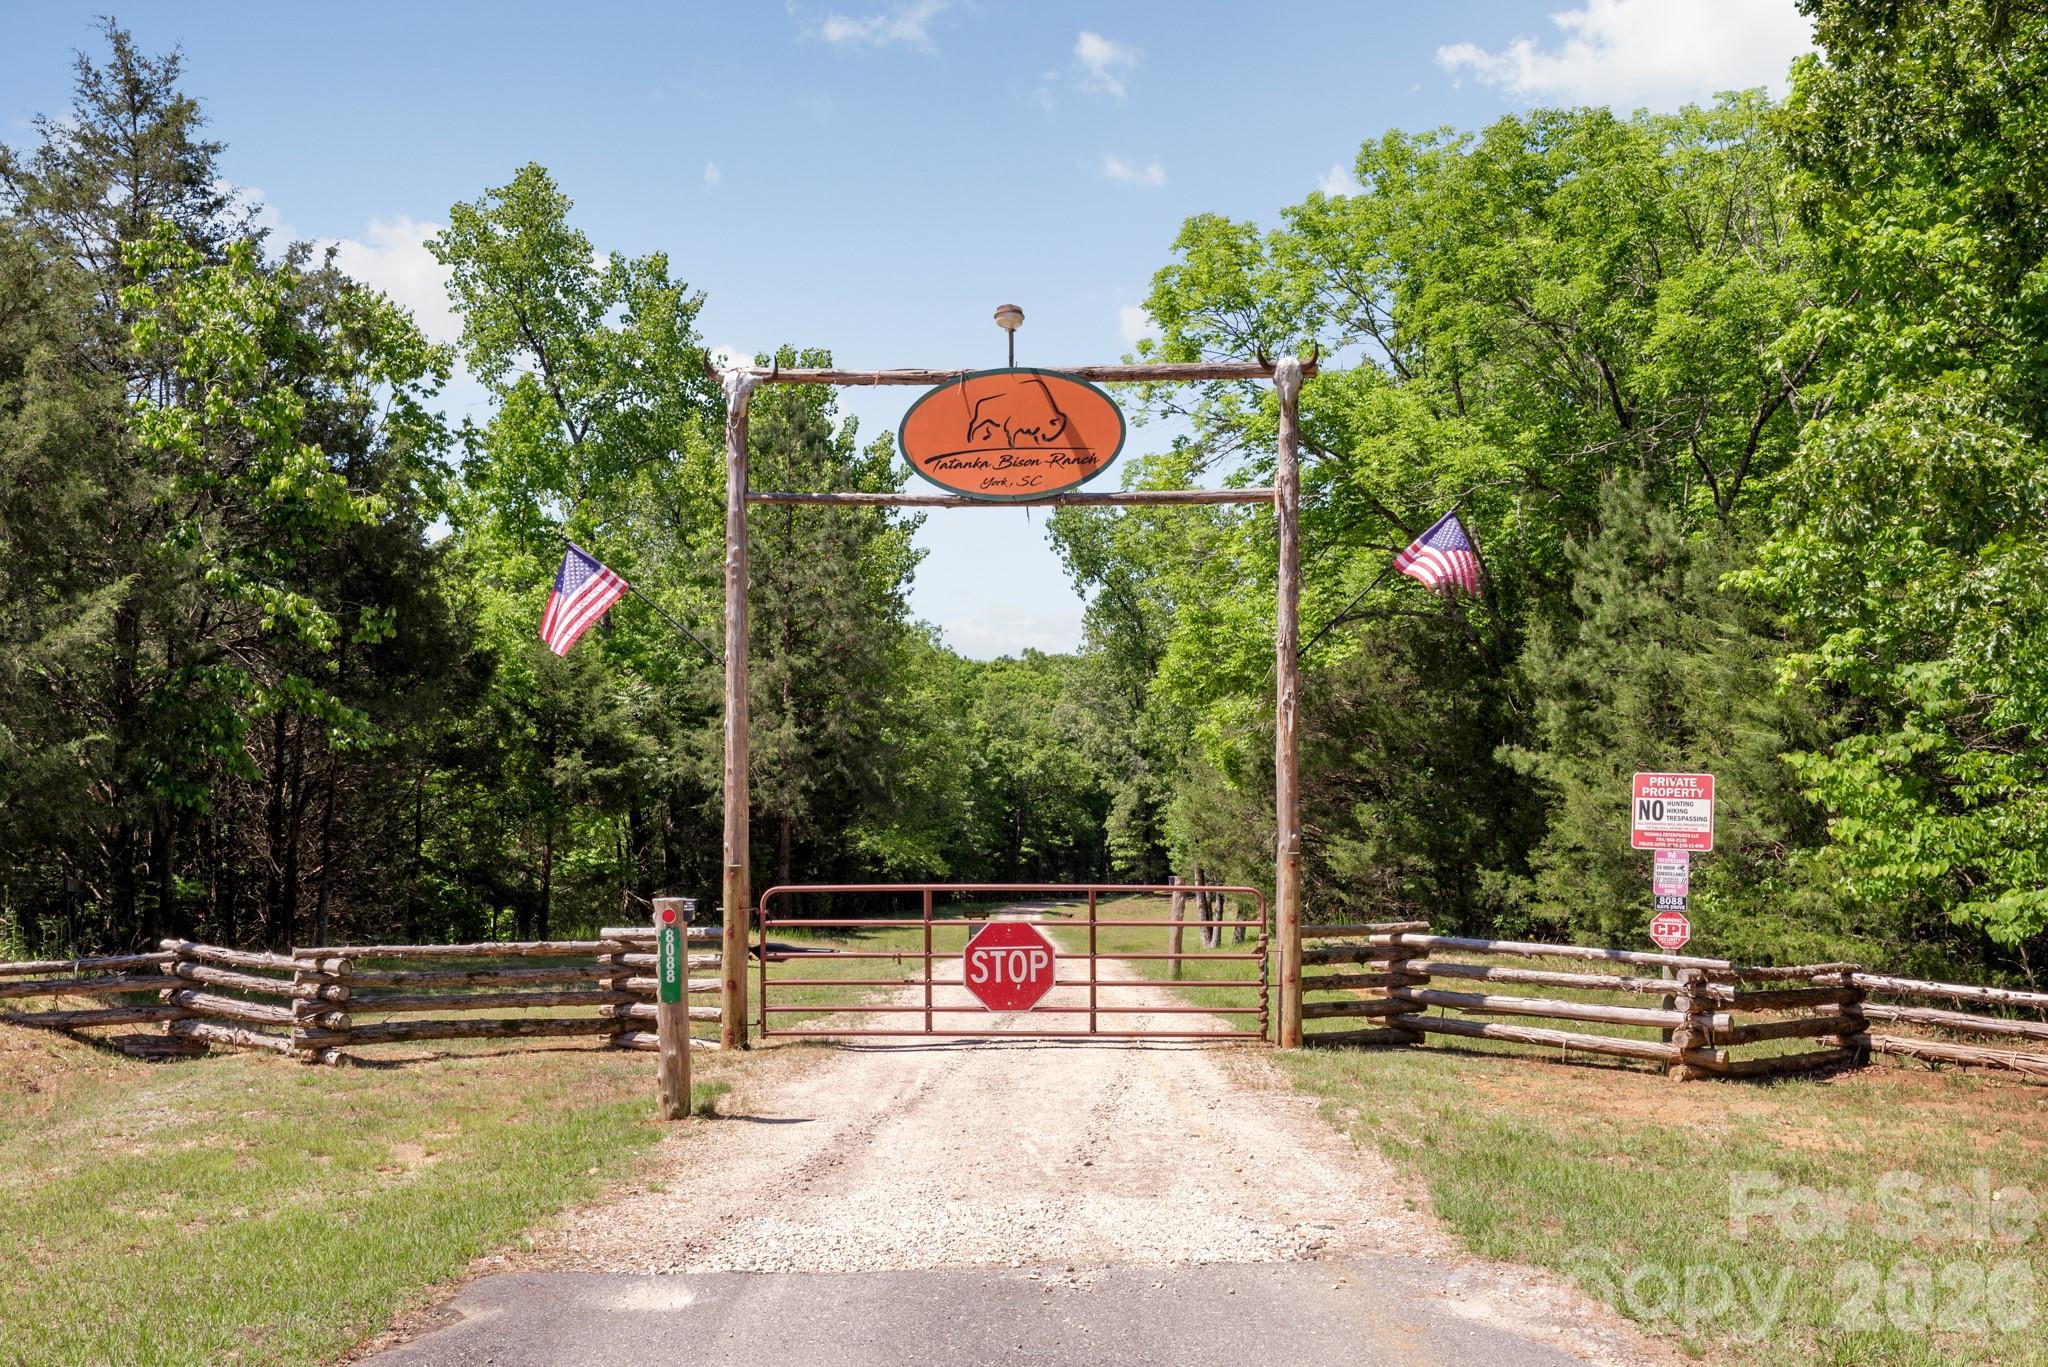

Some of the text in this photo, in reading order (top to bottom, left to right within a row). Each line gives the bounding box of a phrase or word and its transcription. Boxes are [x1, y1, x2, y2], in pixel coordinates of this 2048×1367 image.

[926, 453, 1100, 473] Tatanka Bison Ranch
[980, 475, 1042, 490] York, SC
[1649, 777, 1698, 787] PRIVATE
[1641, 787, 1704, 798] PROPERTY
[1638, 800, 1664, 821] NO
[1659, 896, 1683, 905] 8088
[1653, 923, 1687, 936] CPI
[665, 928, 675, 983] 8088
[970, 950, 1048, 983] STOP
